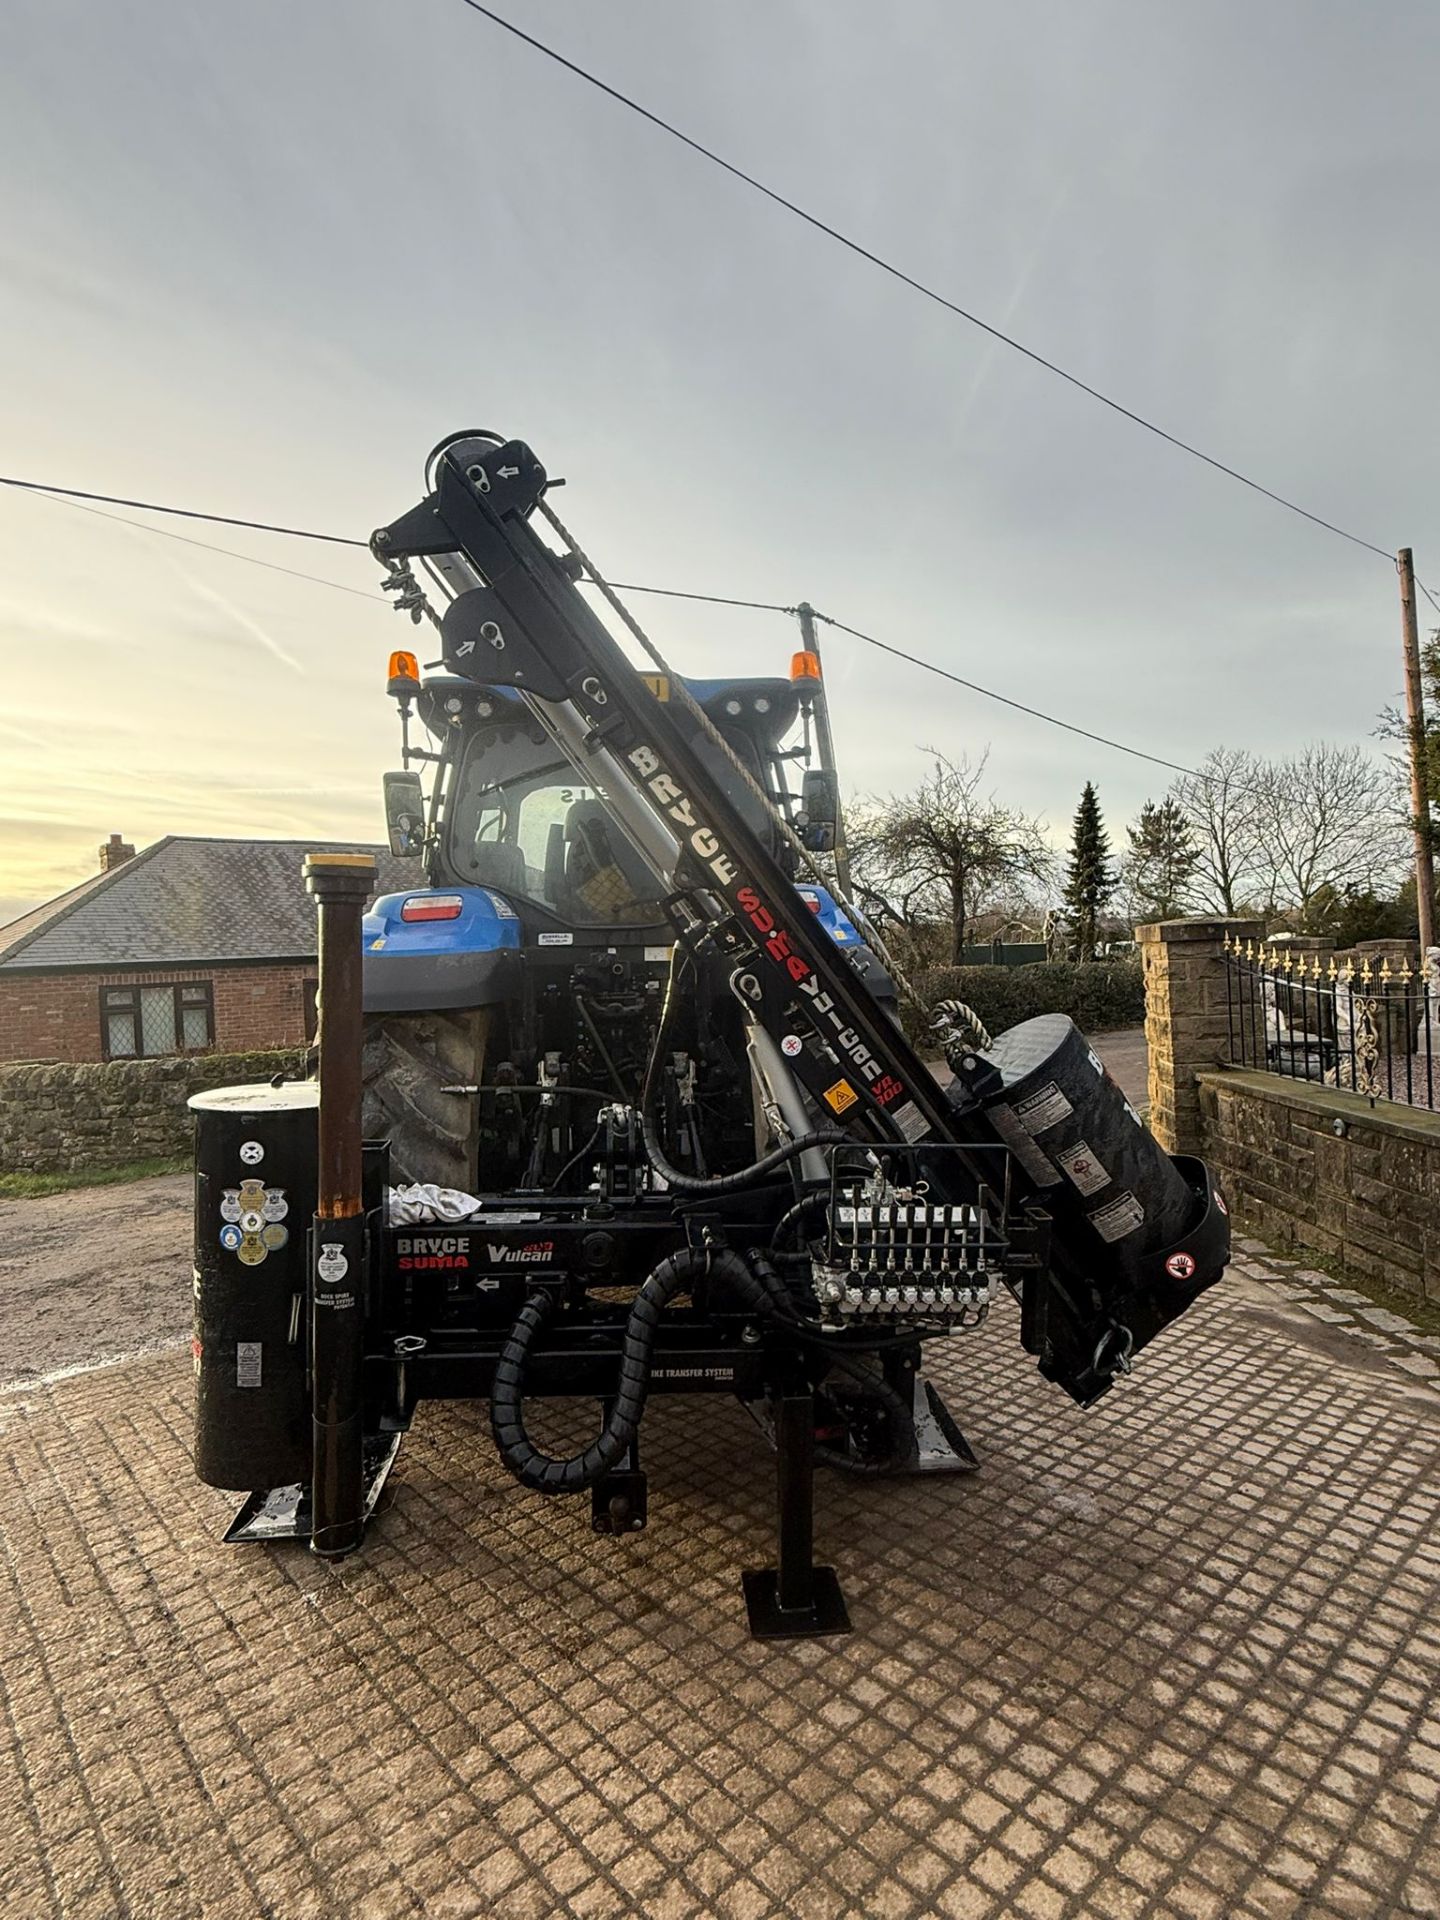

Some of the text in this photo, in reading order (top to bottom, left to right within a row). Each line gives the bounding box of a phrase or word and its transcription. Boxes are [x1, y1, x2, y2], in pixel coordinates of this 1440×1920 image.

[628, 745, 738, 886] BRYCE
[736, 886, 811, 982] SUMA
[397, 1238, 470, 1255] BRYCE
[487, 1243, 553, 1263] Vulcan
[399, 1256, 470, 1269] SUMA
[666, 1368, 704, 1378] TRANSFER
[705, 1367, 734, 1377] SYSTEM
